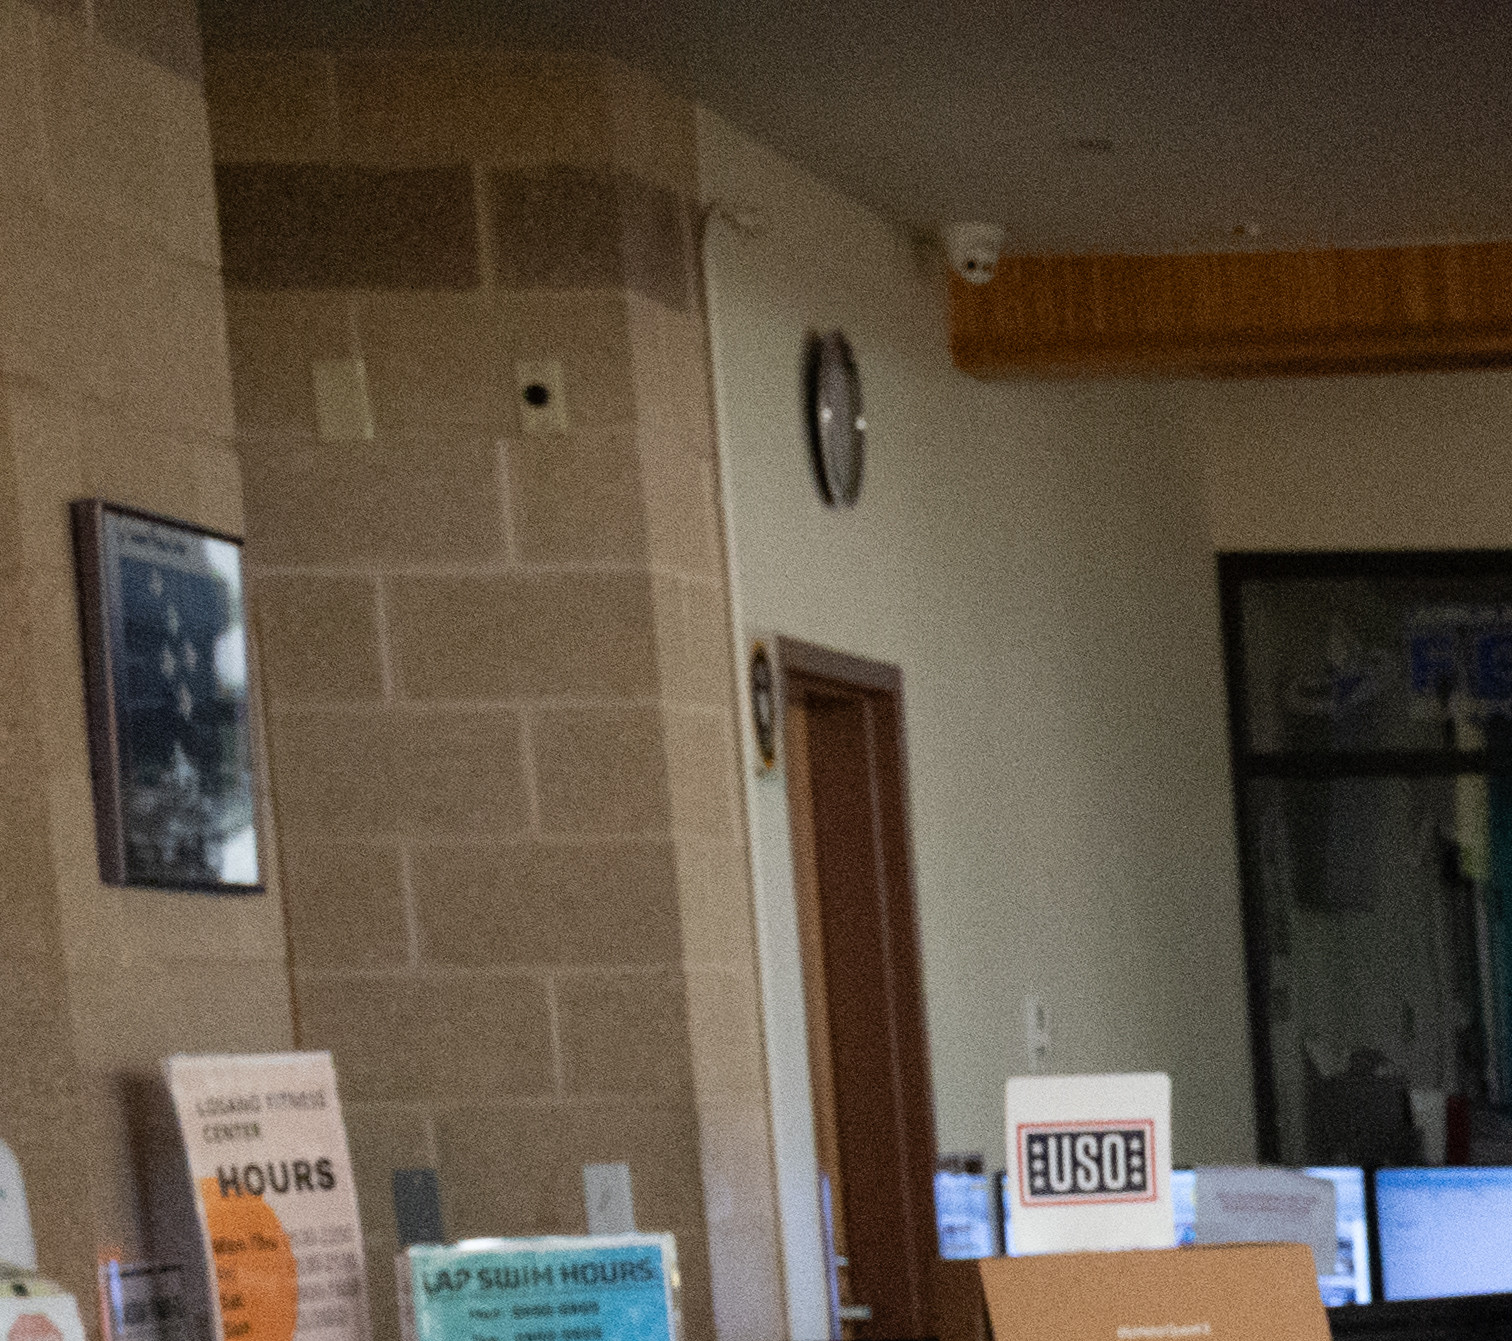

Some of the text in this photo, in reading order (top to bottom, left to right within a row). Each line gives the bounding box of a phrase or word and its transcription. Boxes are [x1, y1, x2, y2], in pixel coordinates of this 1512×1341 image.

[203, 1122, 263, 1144] CENTER
[217, 1157, 337, 1198] HOURS
[1048, 1133, 1130, 1194] USO
[423, 1257, 653, 1294] LAP SWIM HOURS
